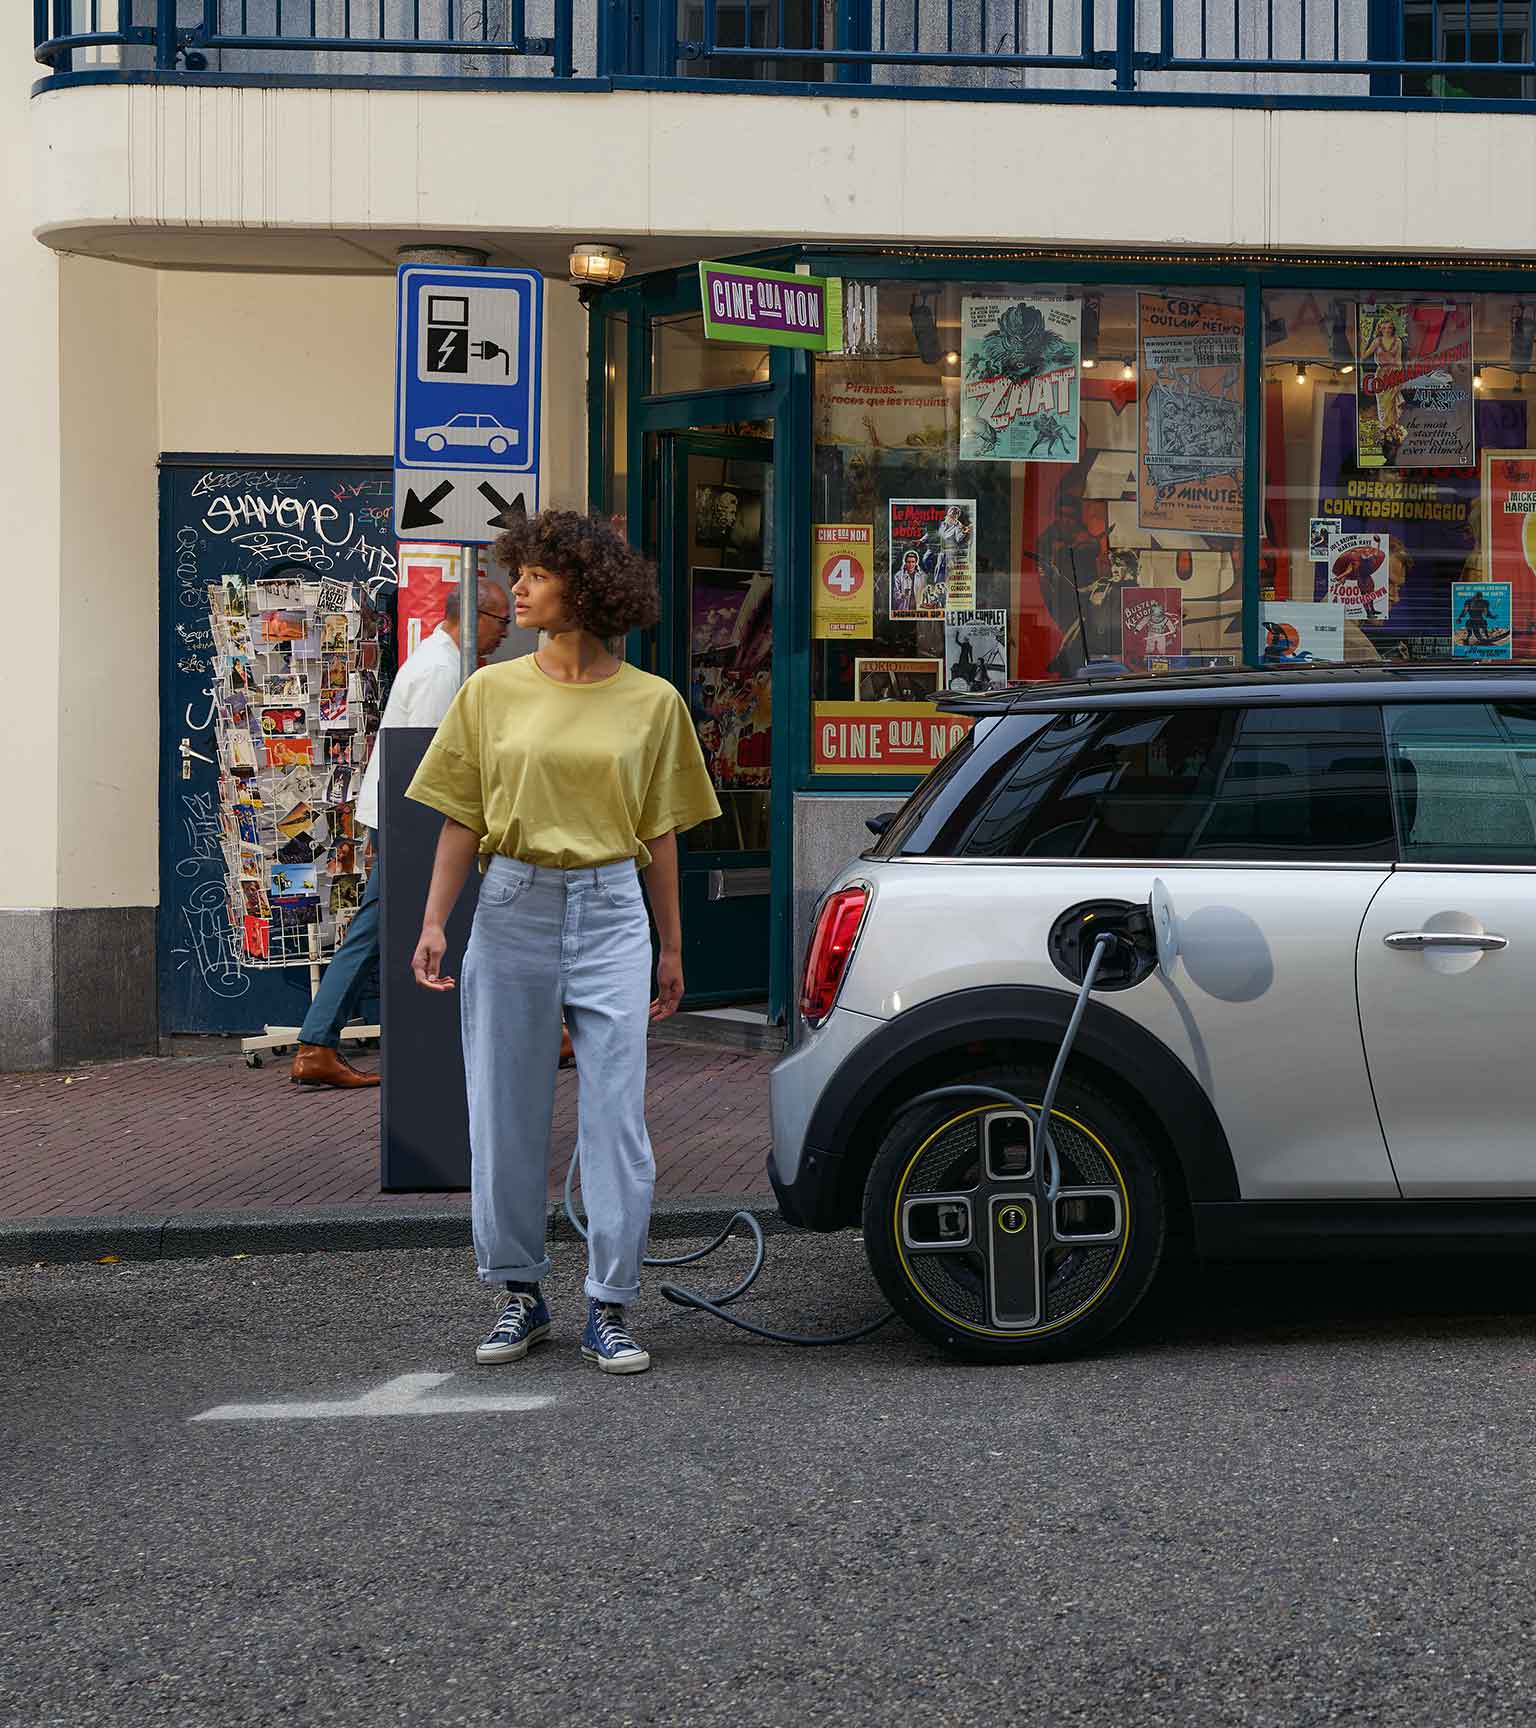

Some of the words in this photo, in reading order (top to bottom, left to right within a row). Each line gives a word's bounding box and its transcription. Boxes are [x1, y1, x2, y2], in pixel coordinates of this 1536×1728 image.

[712, 279, 756, 321] CINE
[757, 281, 782, 311] QUA
[783, 289, 820, 328] NON
[967, 368, 1076, 430] ZAAT
[1347, 480, 1439, 500] OPERAZIONE
[1323, 498, 1467, 520] CONTROSPIONAGGIO
[818, 529, 837, 541] CINE
[850, 530, 867, 541] NON
[828, 559, 855, 593] 4
[957, 610, 974, 626] FILM
[975, 610, 1005, 626] COMPLET
[822, 723, 882, 760] CINE
[888, 720, 924, 747] QUA
[930, 724, 974, 760] NO
